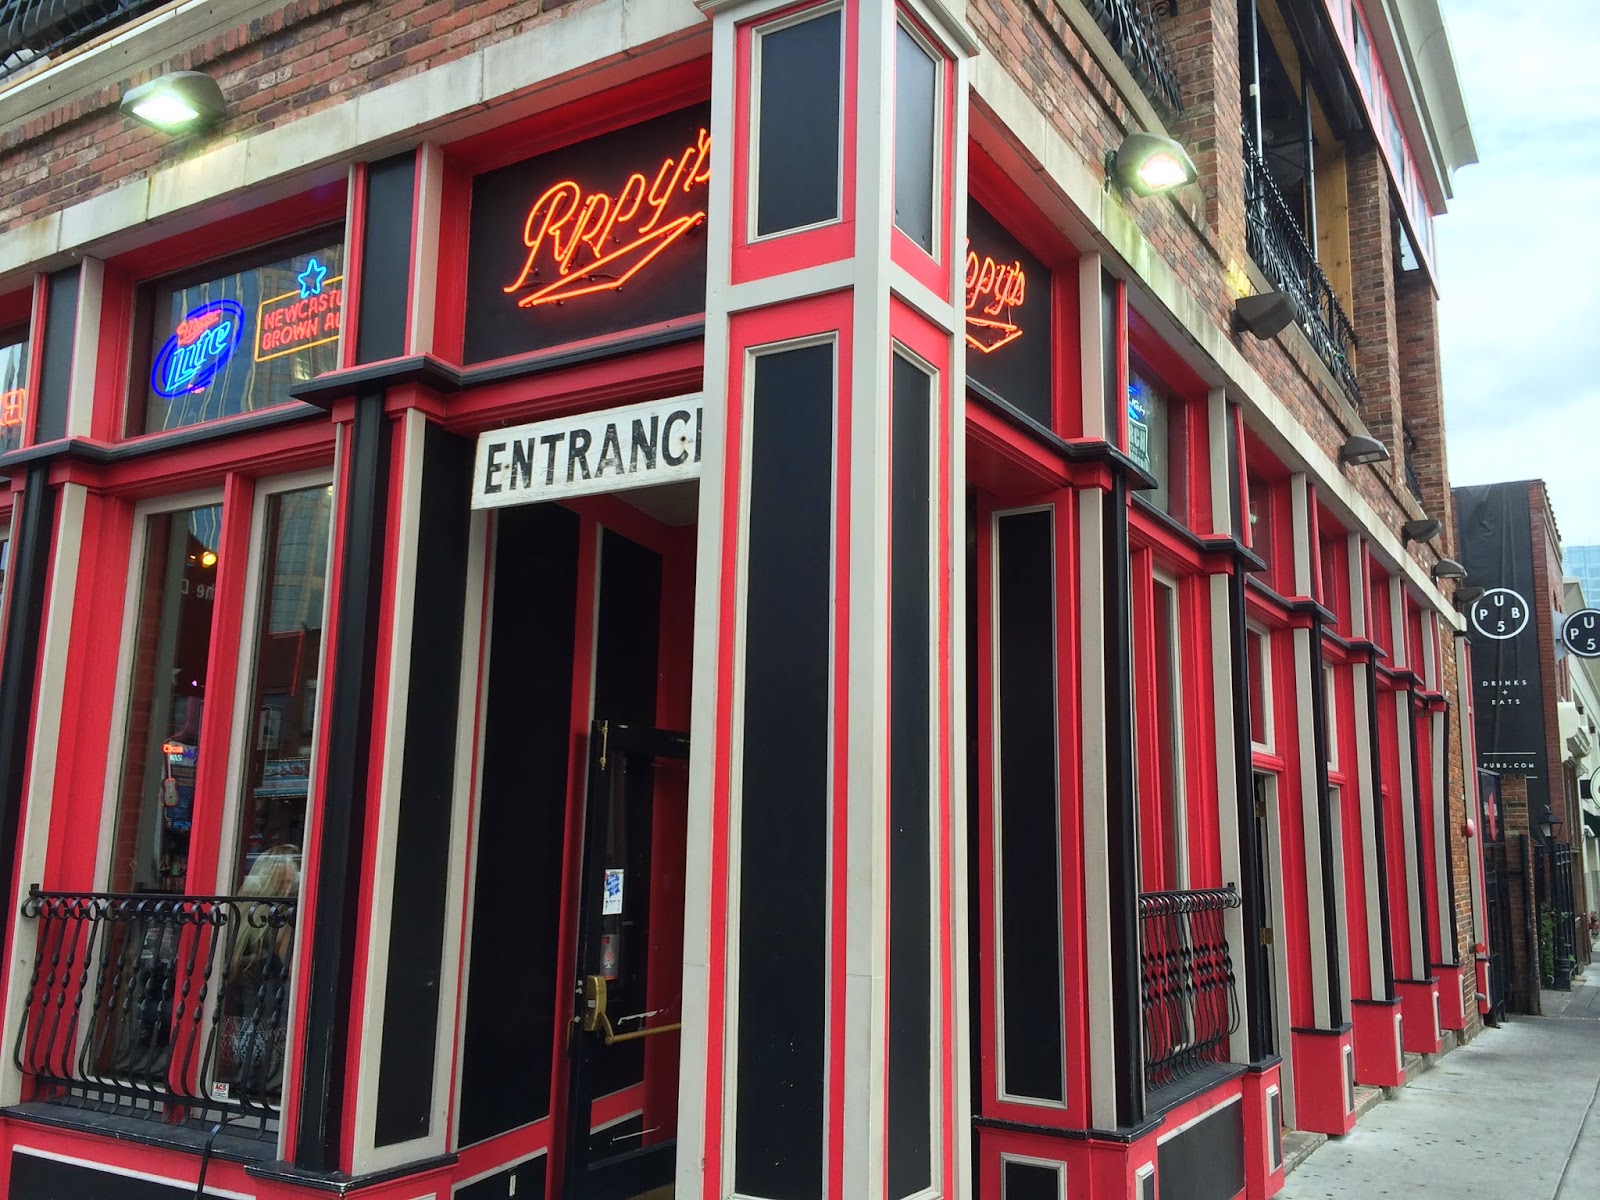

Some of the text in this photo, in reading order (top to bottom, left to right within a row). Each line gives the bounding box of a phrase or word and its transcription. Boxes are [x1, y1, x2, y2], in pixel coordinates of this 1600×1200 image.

[262, 311, 341, 351] BROWN AL
[263, 289, 342, 331] NEWCASTL
[164, 321, 231, 392] Lite
